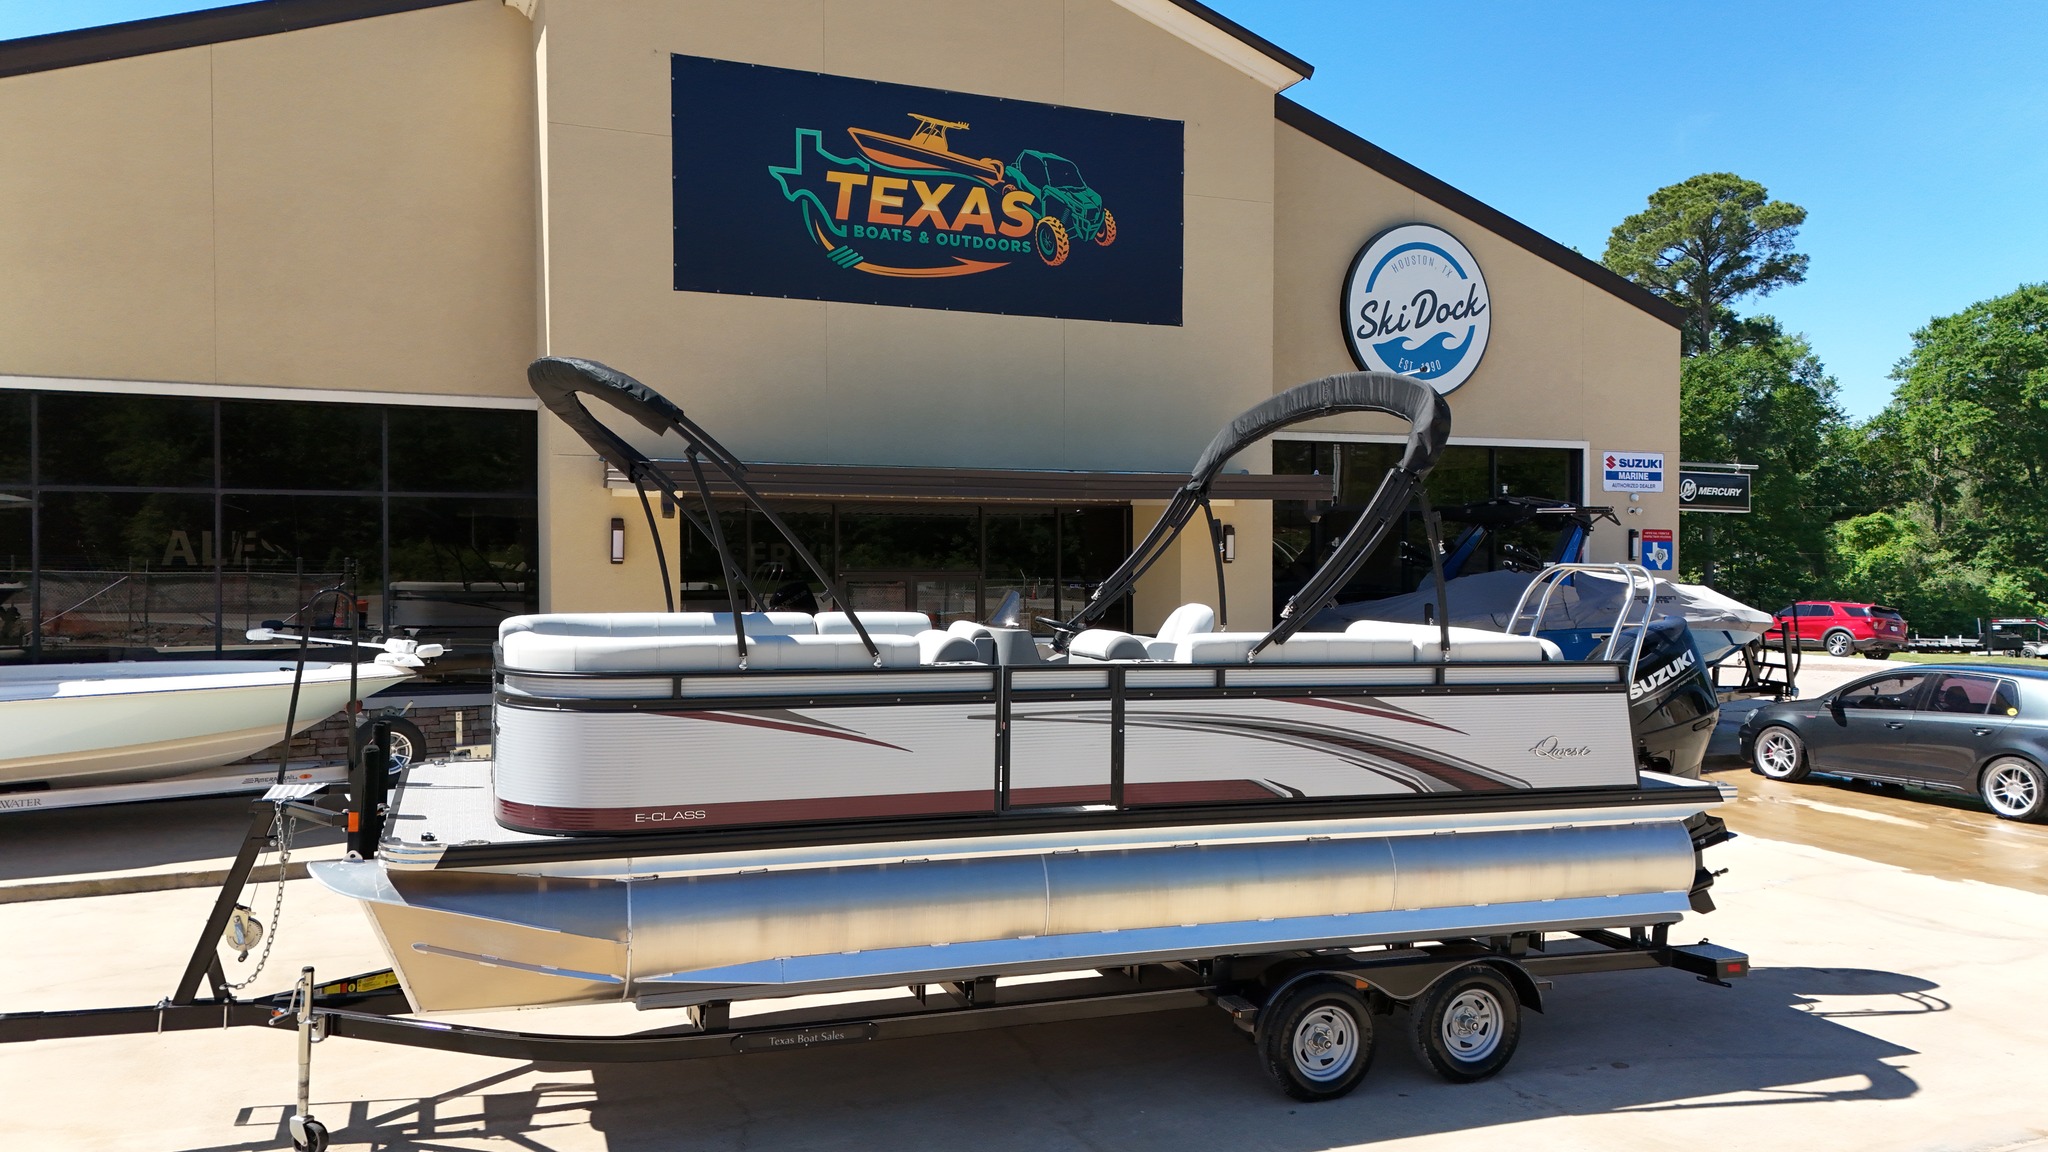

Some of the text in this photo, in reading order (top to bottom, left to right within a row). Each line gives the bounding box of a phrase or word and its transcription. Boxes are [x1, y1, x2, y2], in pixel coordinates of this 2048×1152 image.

[826, 170, 1036, 238] TEXAS
[853, 224, 1032, 254] BOATS & OUTDOORS
[1391, 254, 1453, 278] HOUSTON, TX
[1618, 458, 1662, 469] SUZUKI
[1618, 471, 1650, 481] MARINE
[1697, 486, 1743, 497] MERCURY
[1630, 649, 1696, 700] SUZUKI
[635, 810, 706, 823] E-CLASS
[768, 1030, 845, 1047] Texas Boat Sales
